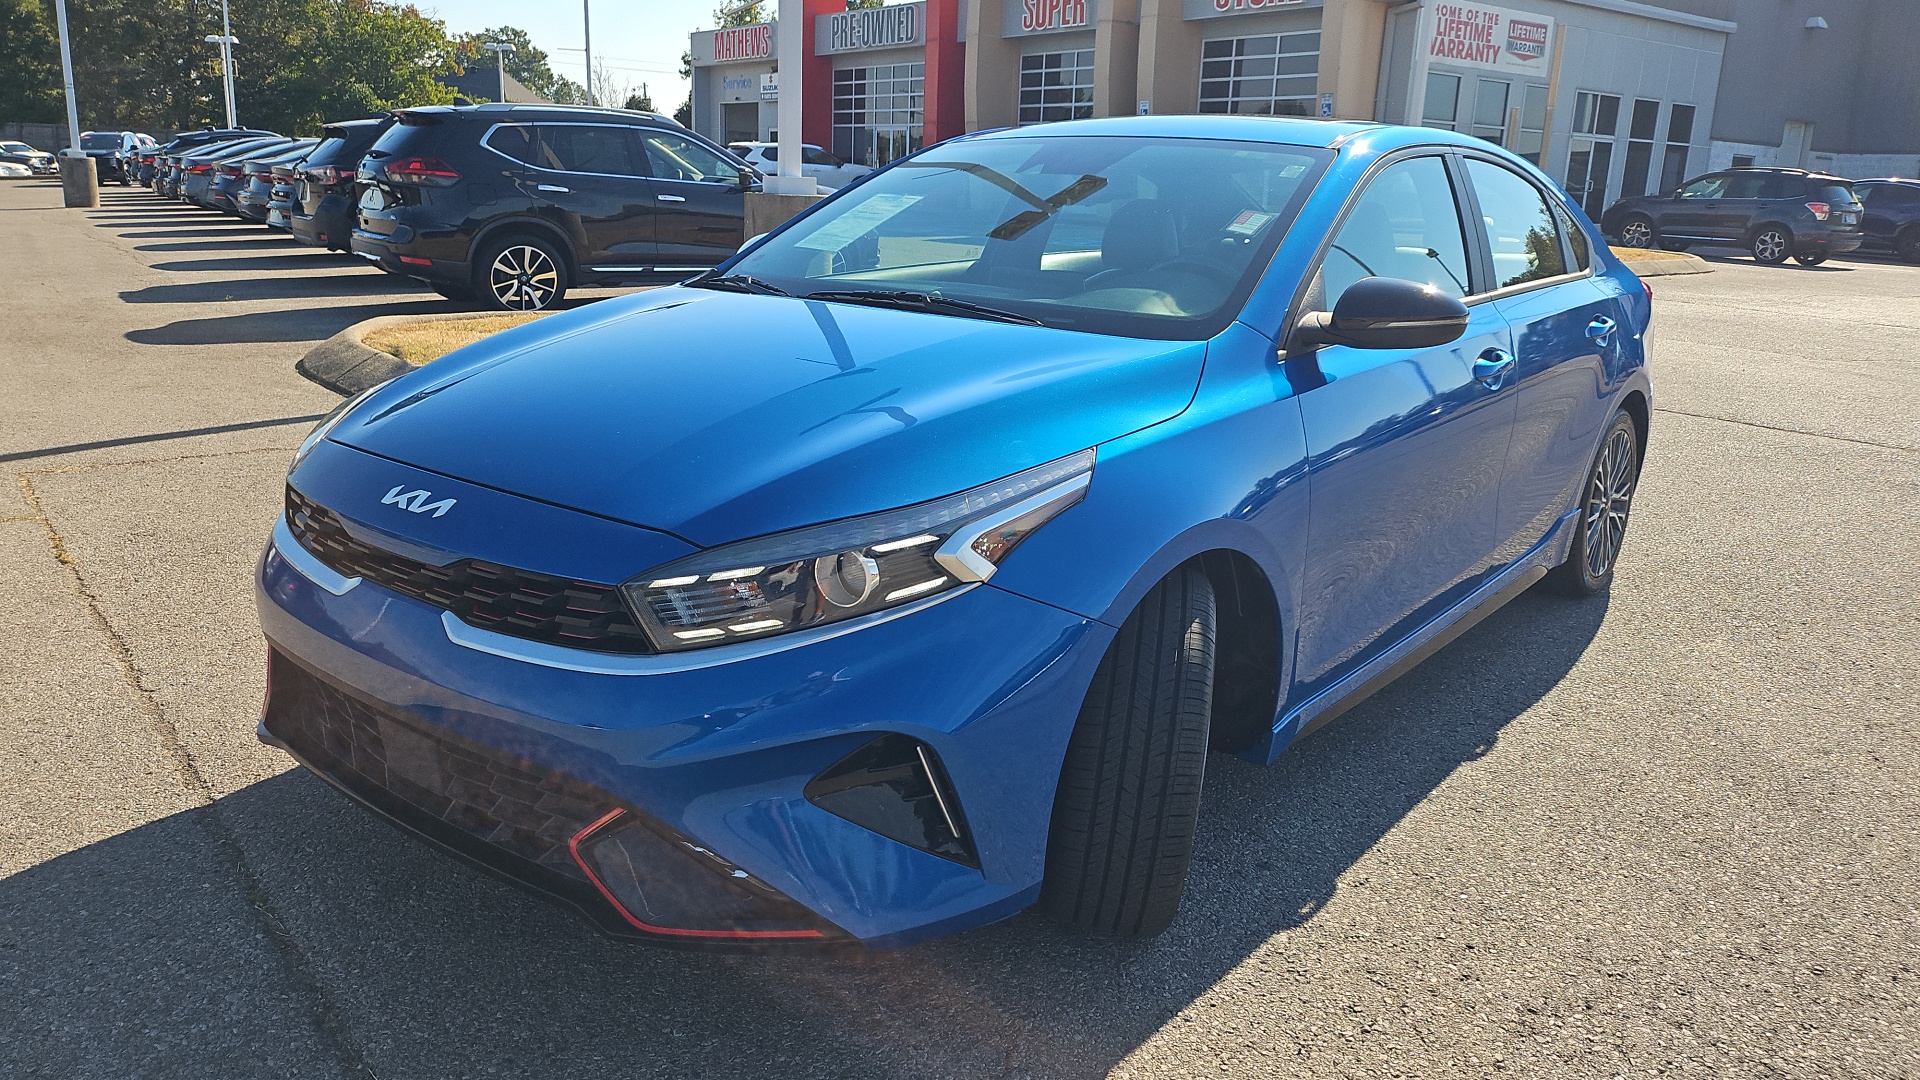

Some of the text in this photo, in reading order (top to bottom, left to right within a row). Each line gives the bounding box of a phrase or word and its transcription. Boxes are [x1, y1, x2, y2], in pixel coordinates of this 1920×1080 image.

[831, 5, 915, 50] PRE-OWNED
[1022, 0, 1087, 31] SUPER
[1466, 9, 1480, 22] OF
[1483, 11, 1500, 26] THE
[1436, 16, 1493, 44] LIFETIME
[1510, 22, 1546, 42] LIFETIME
[714, 25, 770, 61] MATHEWS
[1508, 39, 1545, 57] WARRANTY
[723, 75, 752, 90] Service
[762, 84, 778, 92] SUZUK
[380, 484, 457, 518] KIA
